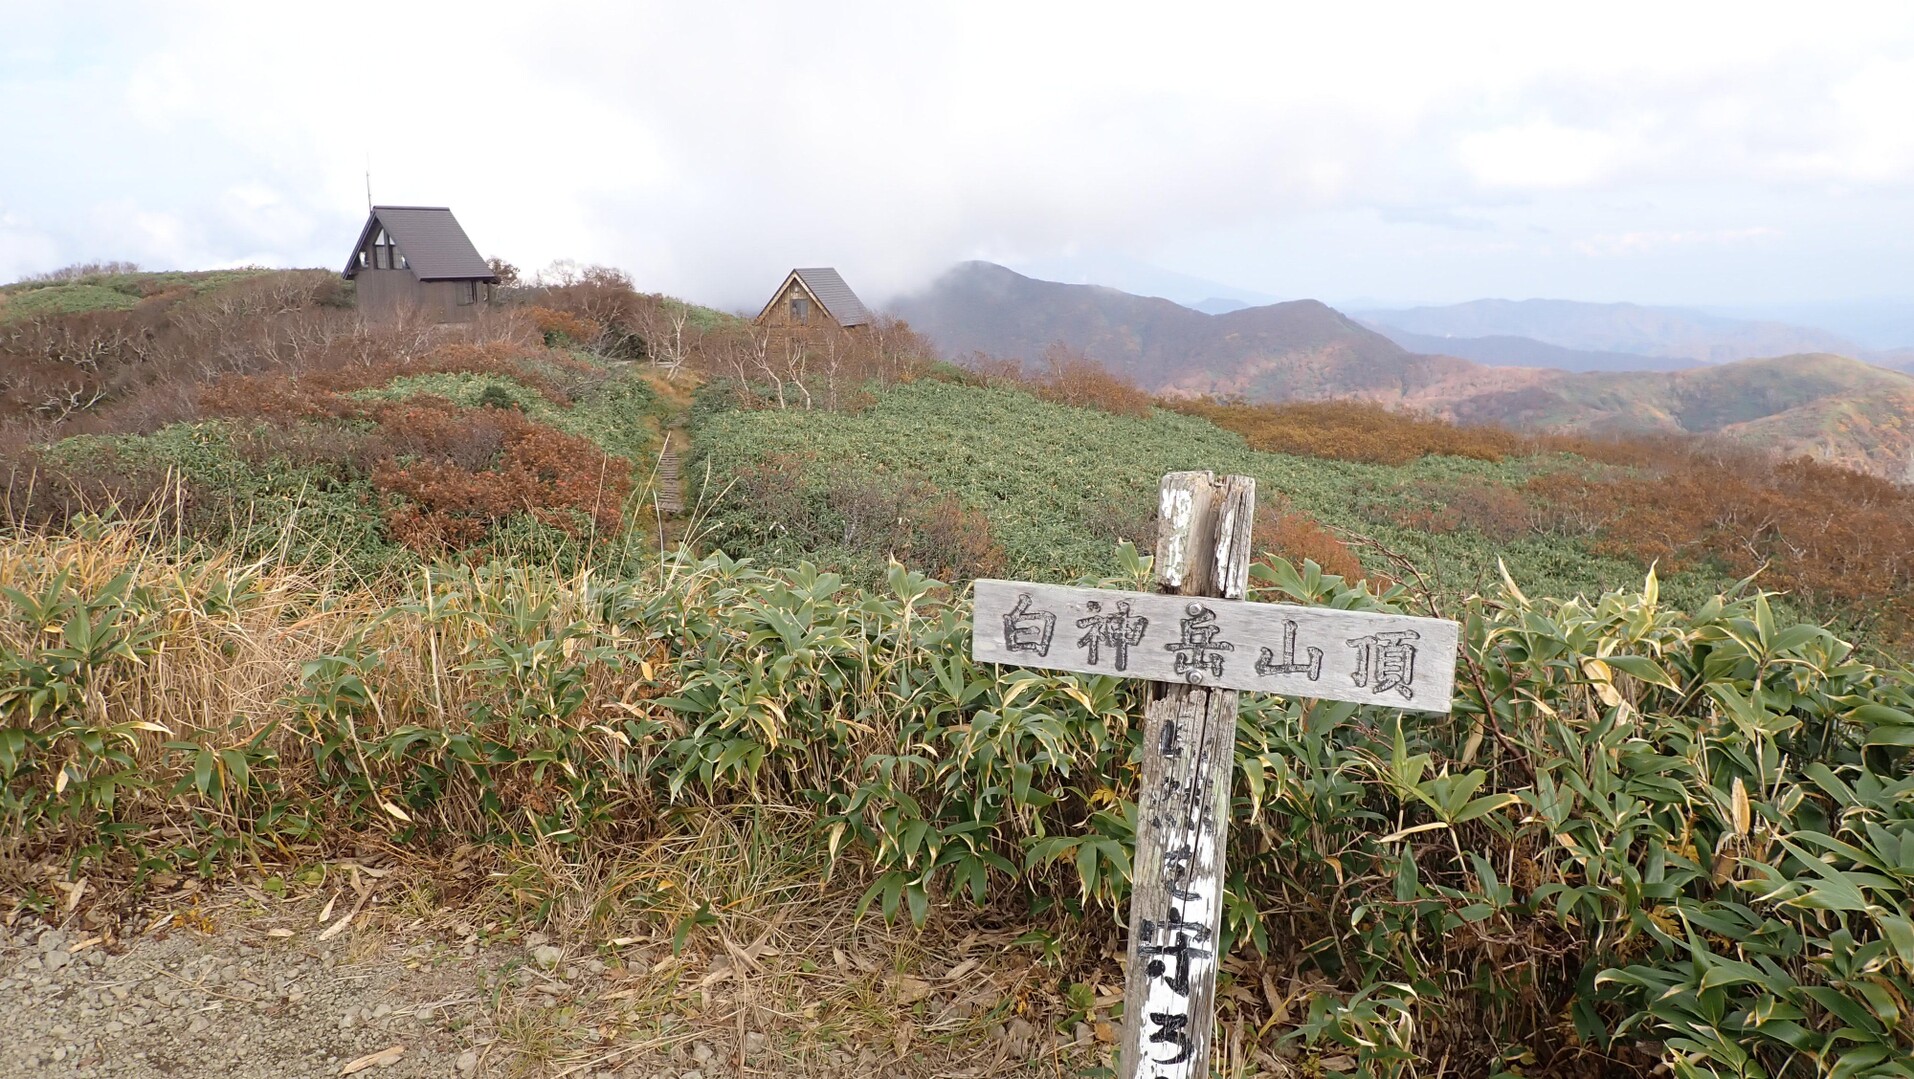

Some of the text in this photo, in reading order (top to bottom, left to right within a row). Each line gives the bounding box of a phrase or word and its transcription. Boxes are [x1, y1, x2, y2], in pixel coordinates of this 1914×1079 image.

[1003, 593, 1421, 700] 白神岳山頂
